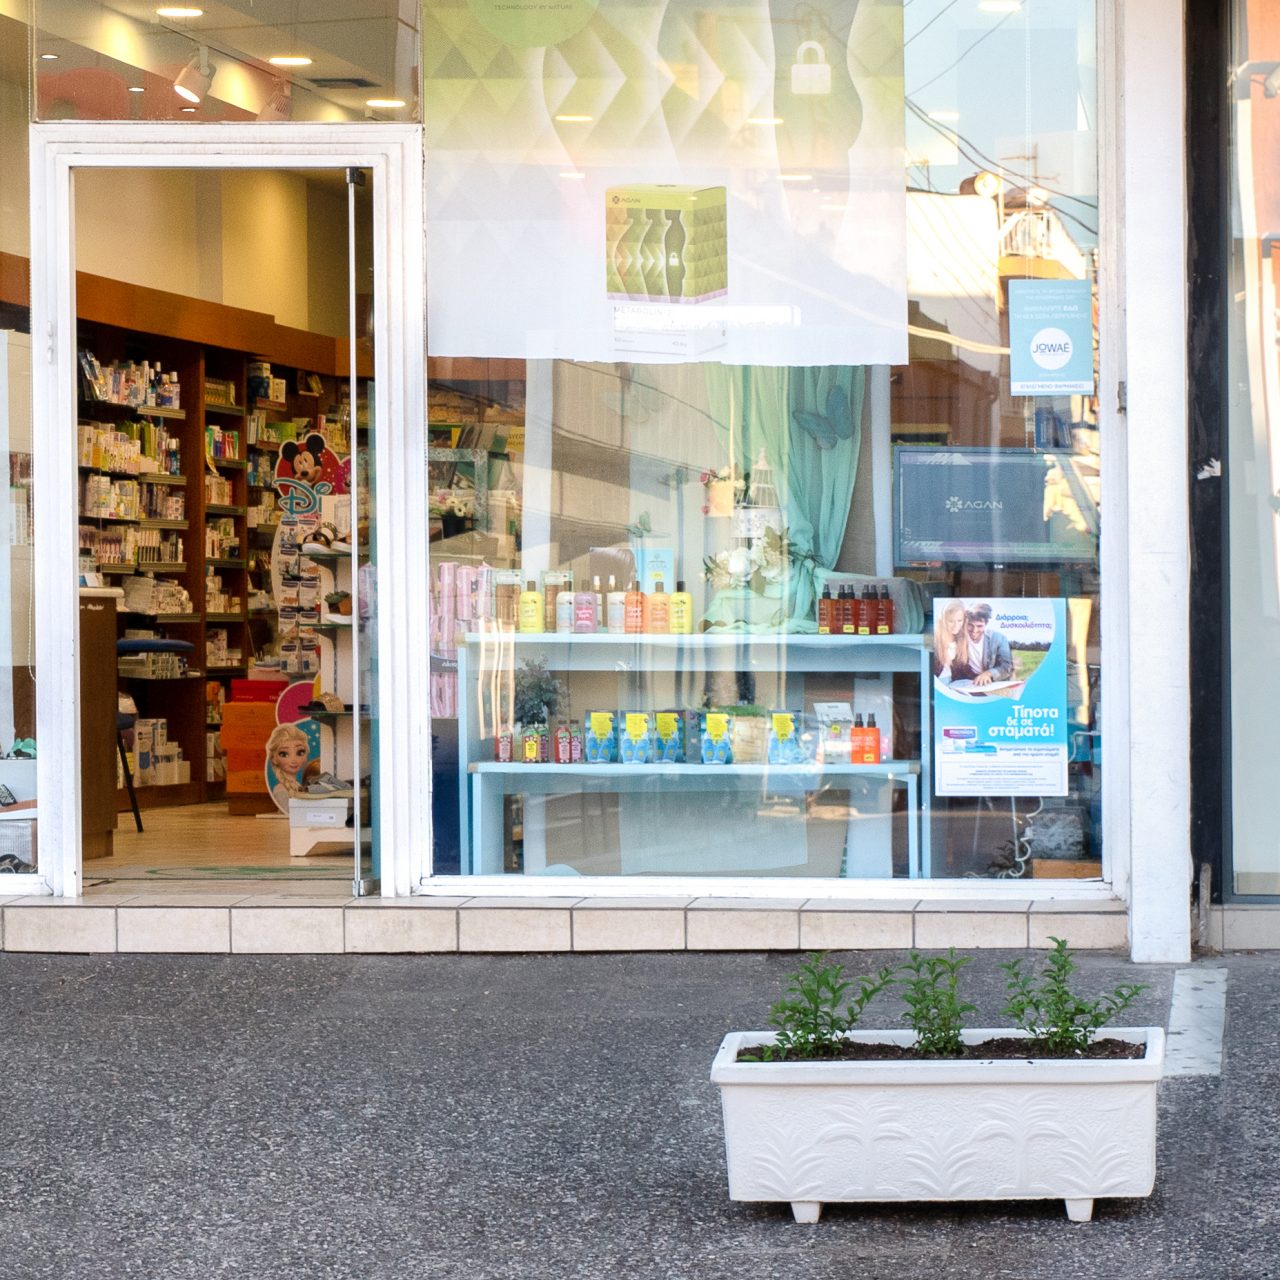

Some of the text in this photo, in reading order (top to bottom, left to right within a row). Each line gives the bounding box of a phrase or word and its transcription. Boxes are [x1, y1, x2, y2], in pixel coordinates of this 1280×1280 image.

[964, 500, 1003, 509] AGAN
[1011, 704, 1059, 719] Τίποτα
[1006, 716, 1033, 726] δε σε
[988, 723, 1055, 740] σταματά!
